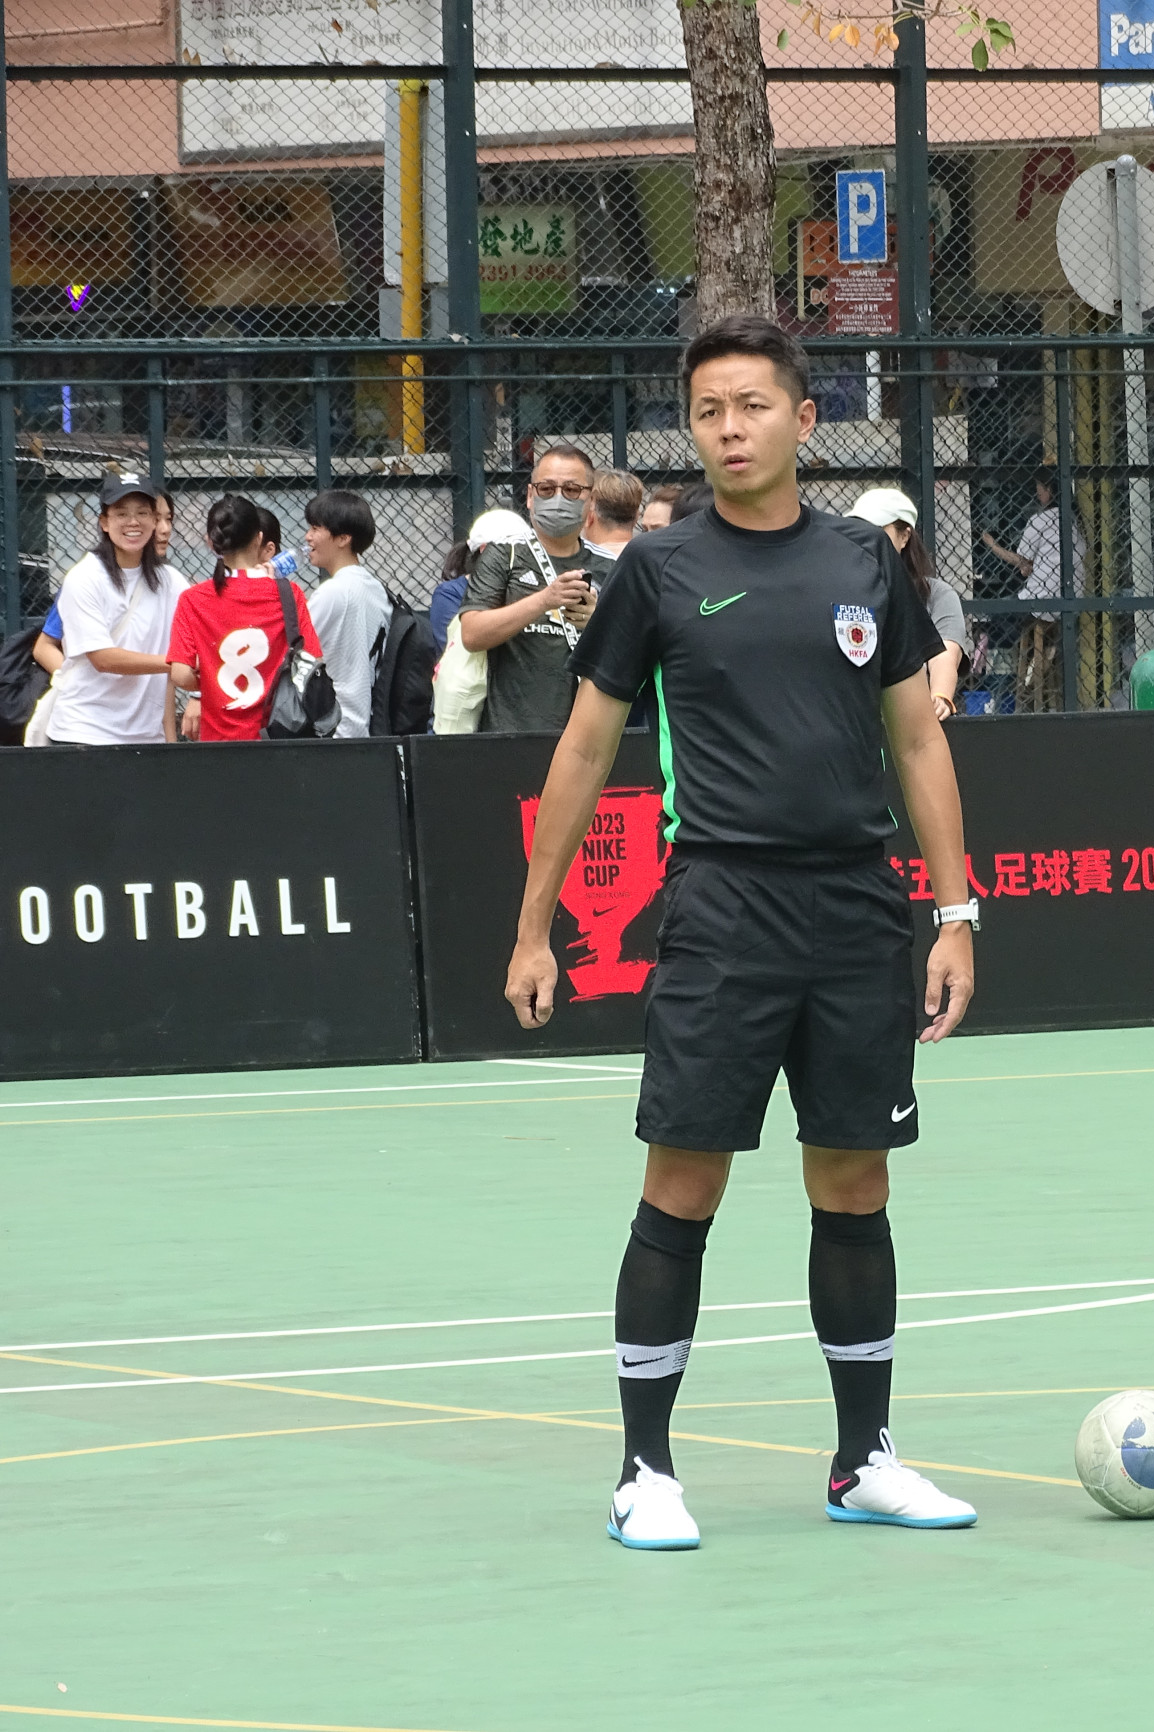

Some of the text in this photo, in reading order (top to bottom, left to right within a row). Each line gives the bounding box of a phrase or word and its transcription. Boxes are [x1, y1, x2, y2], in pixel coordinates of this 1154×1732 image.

[849, 182, 877, 253] P
[836, 611, 874, 623] REFEREE
[839, 604, 871, 616] FUTSAL
[848, 649, 868, 658] HKFA
[217, 627, 269, 710] 8
[581, 838, 627, 862] NIKE
[583, 864, 620, 887] CUP
[19, 876, 351, 945] OOTBALL
